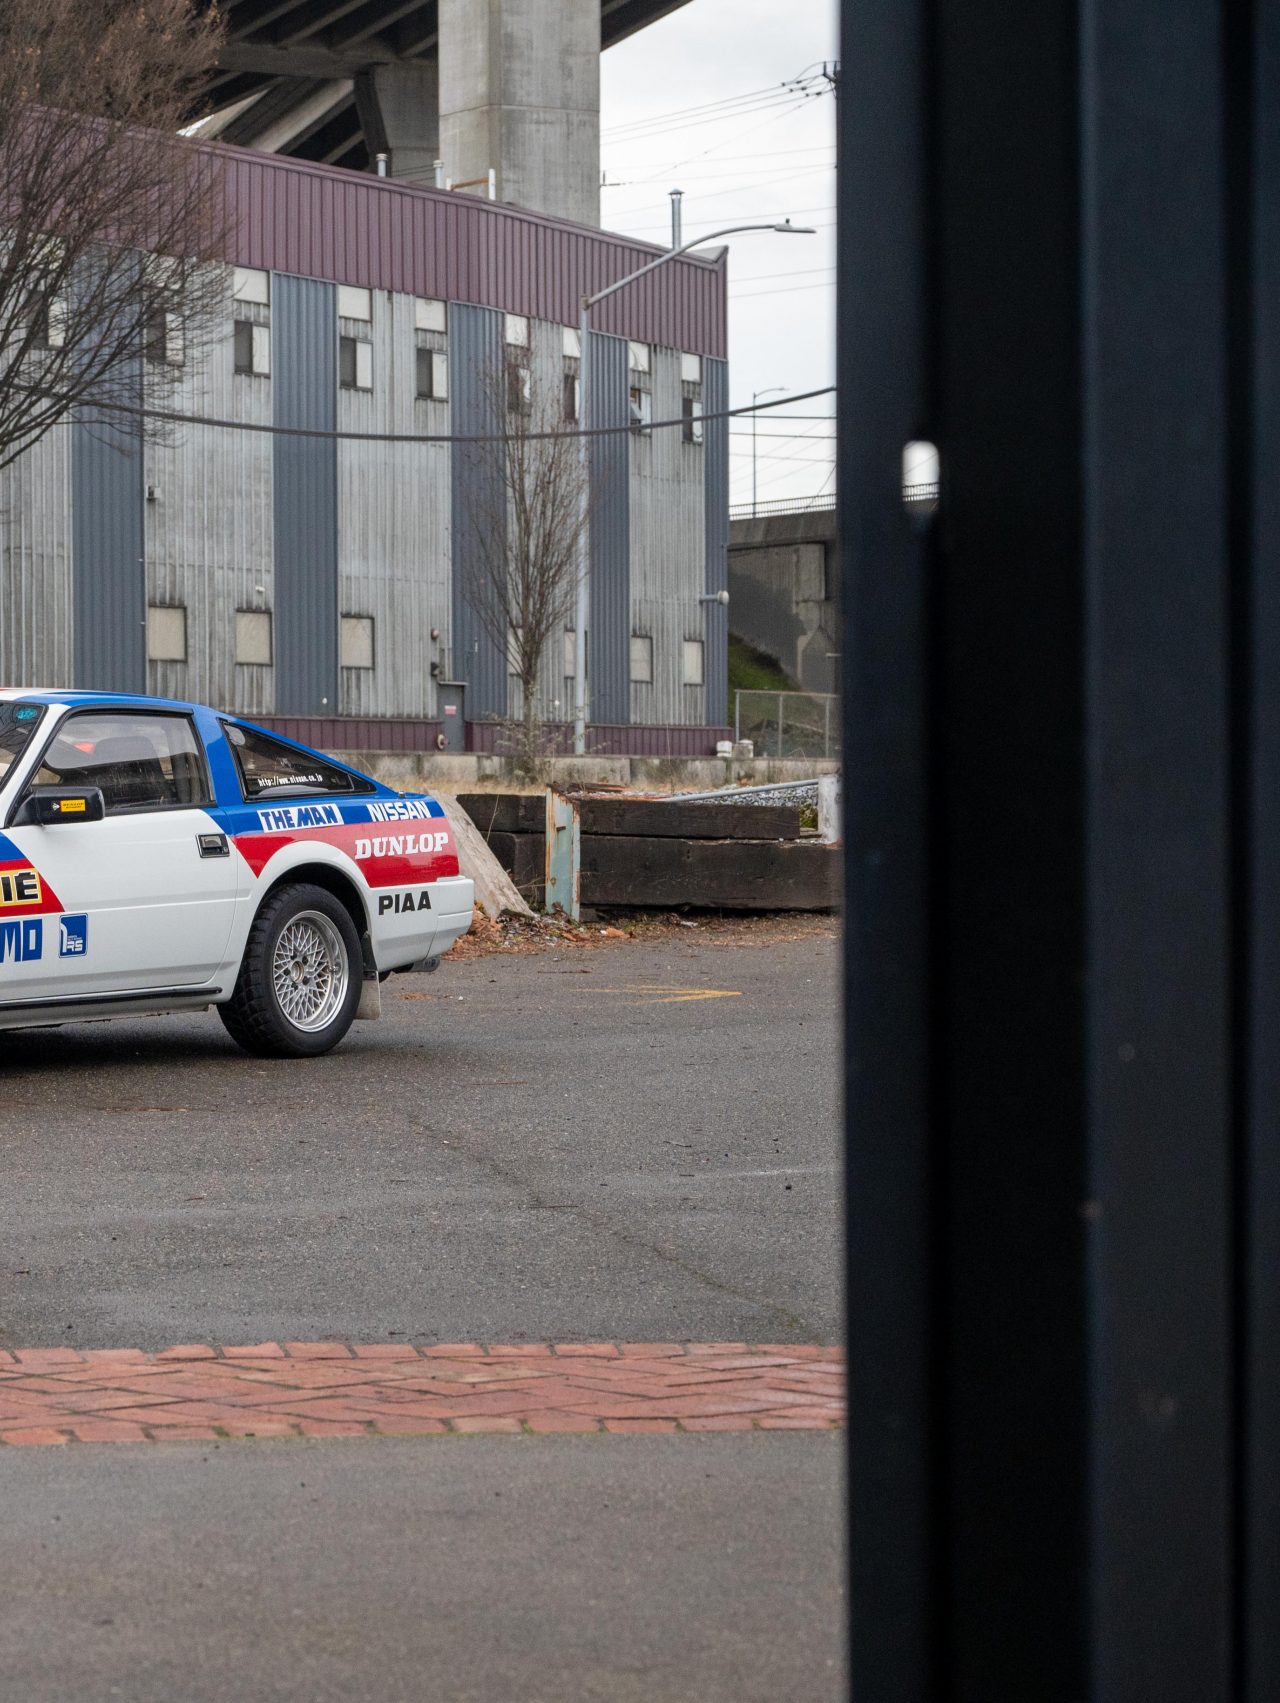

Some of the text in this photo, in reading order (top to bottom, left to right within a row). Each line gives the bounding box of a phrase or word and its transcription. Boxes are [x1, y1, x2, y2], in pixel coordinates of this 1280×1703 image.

[261, 805, 338, 831] THE MAN
[366, 800, 432, 822] NISSAN
[355, 832, 449, 860] DUNLOP
[378, 890, 432, 915] PIAA
